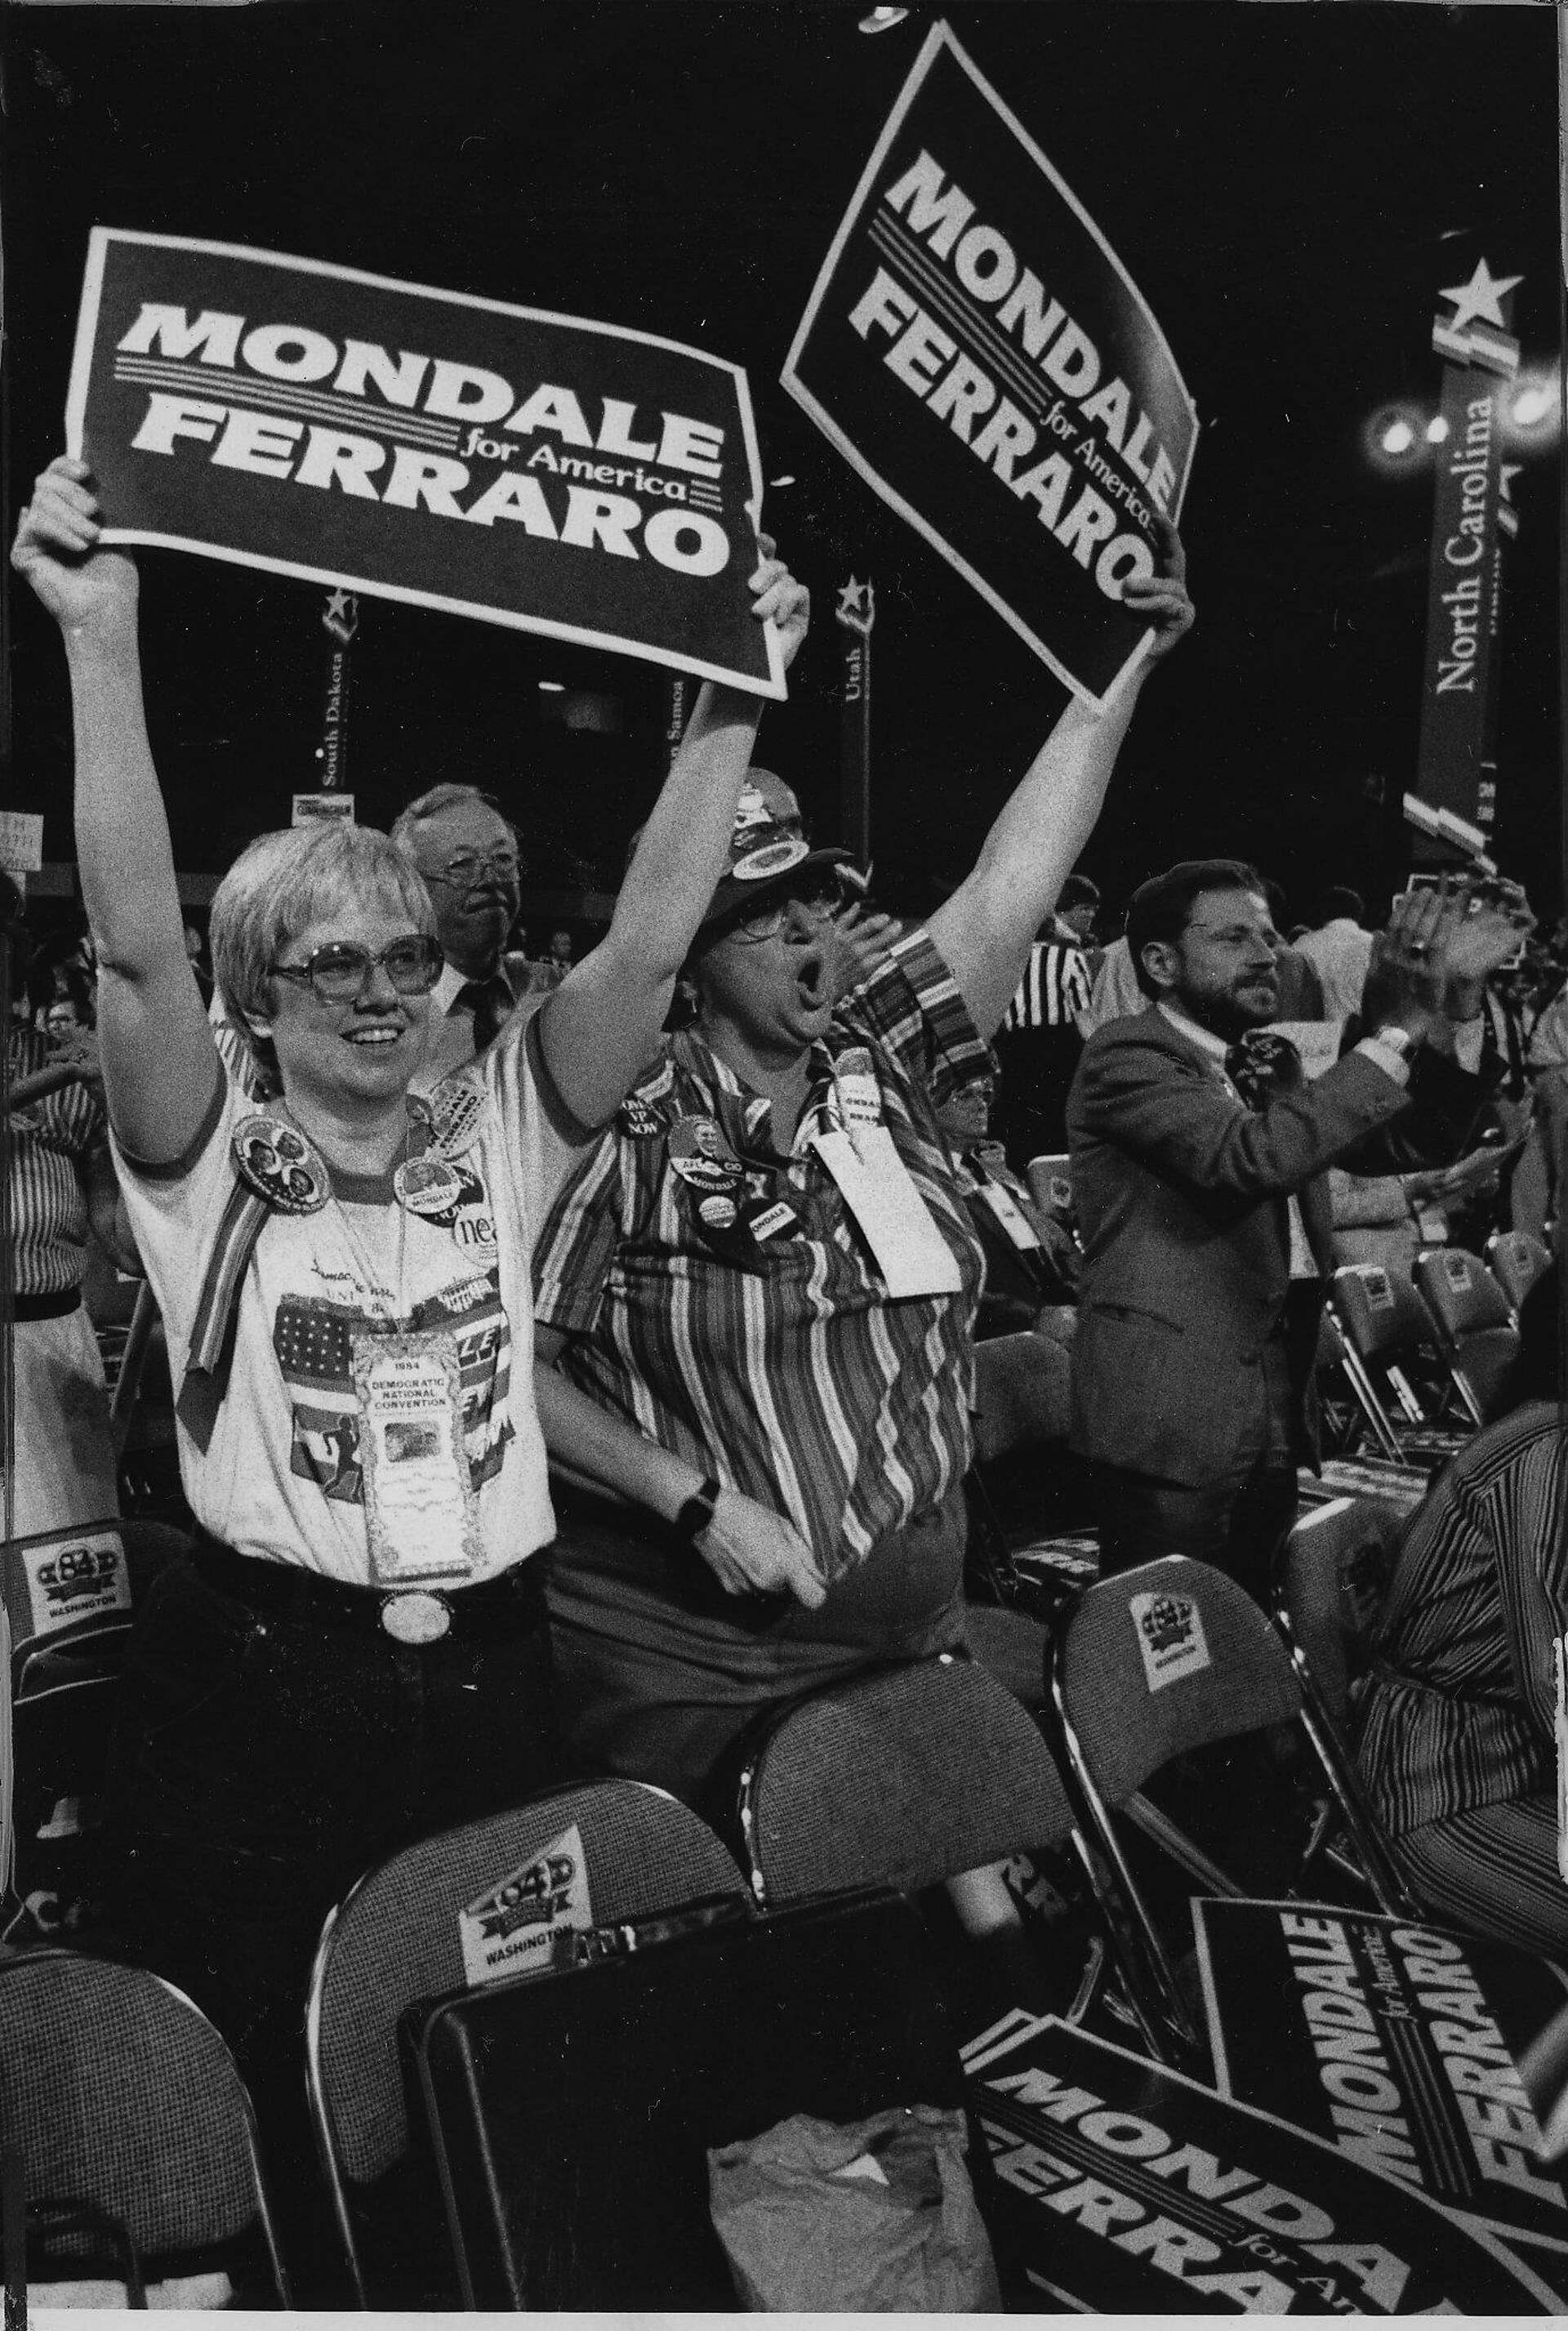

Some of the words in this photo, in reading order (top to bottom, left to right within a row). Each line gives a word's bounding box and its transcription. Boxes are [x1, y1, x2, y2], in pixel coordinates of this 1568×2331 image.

[884, 148, 1177, 515] MONDALE
[116, 301, 725, 479] MONDALE
[848, 266, 1154, 600] FERRARO
[131, 392, 730, 577] FERRARO
[460, 428, 519, 461] for
[527, 444, 687, 501] America
[1040, 400, 1078, 440] for
[1074, 437, 1150, 528] America
[1445, 396, 1492, 567] Carolina
[845, 646, 862, 702] Utah
[1436, 574, 1481, 695] North
[327, 653, 343, 722] Dakota
[323, 728, 338, 787] South
[751, 1207, 786, 1232] ONDALE
[372, 1378, 444, 1390] DEMOCRATIC
[375, 1399, 446, 1410] CONVENTION
[383, 1389, 435, 1399] NATIONAL
[395, 1362, 419, 1371] 1984
[49, 1594, 117, 1618] WASHINGTON
[1280, 1913, 1423, 2186] MONDALE
[1391, 1929, 1567, 2209] FERRARO
[980, 2118, 1296, 2315] ERRA
[984, 2067, 1470, 2315] MONDA
[1227, 2233, 1298, 2266] for
